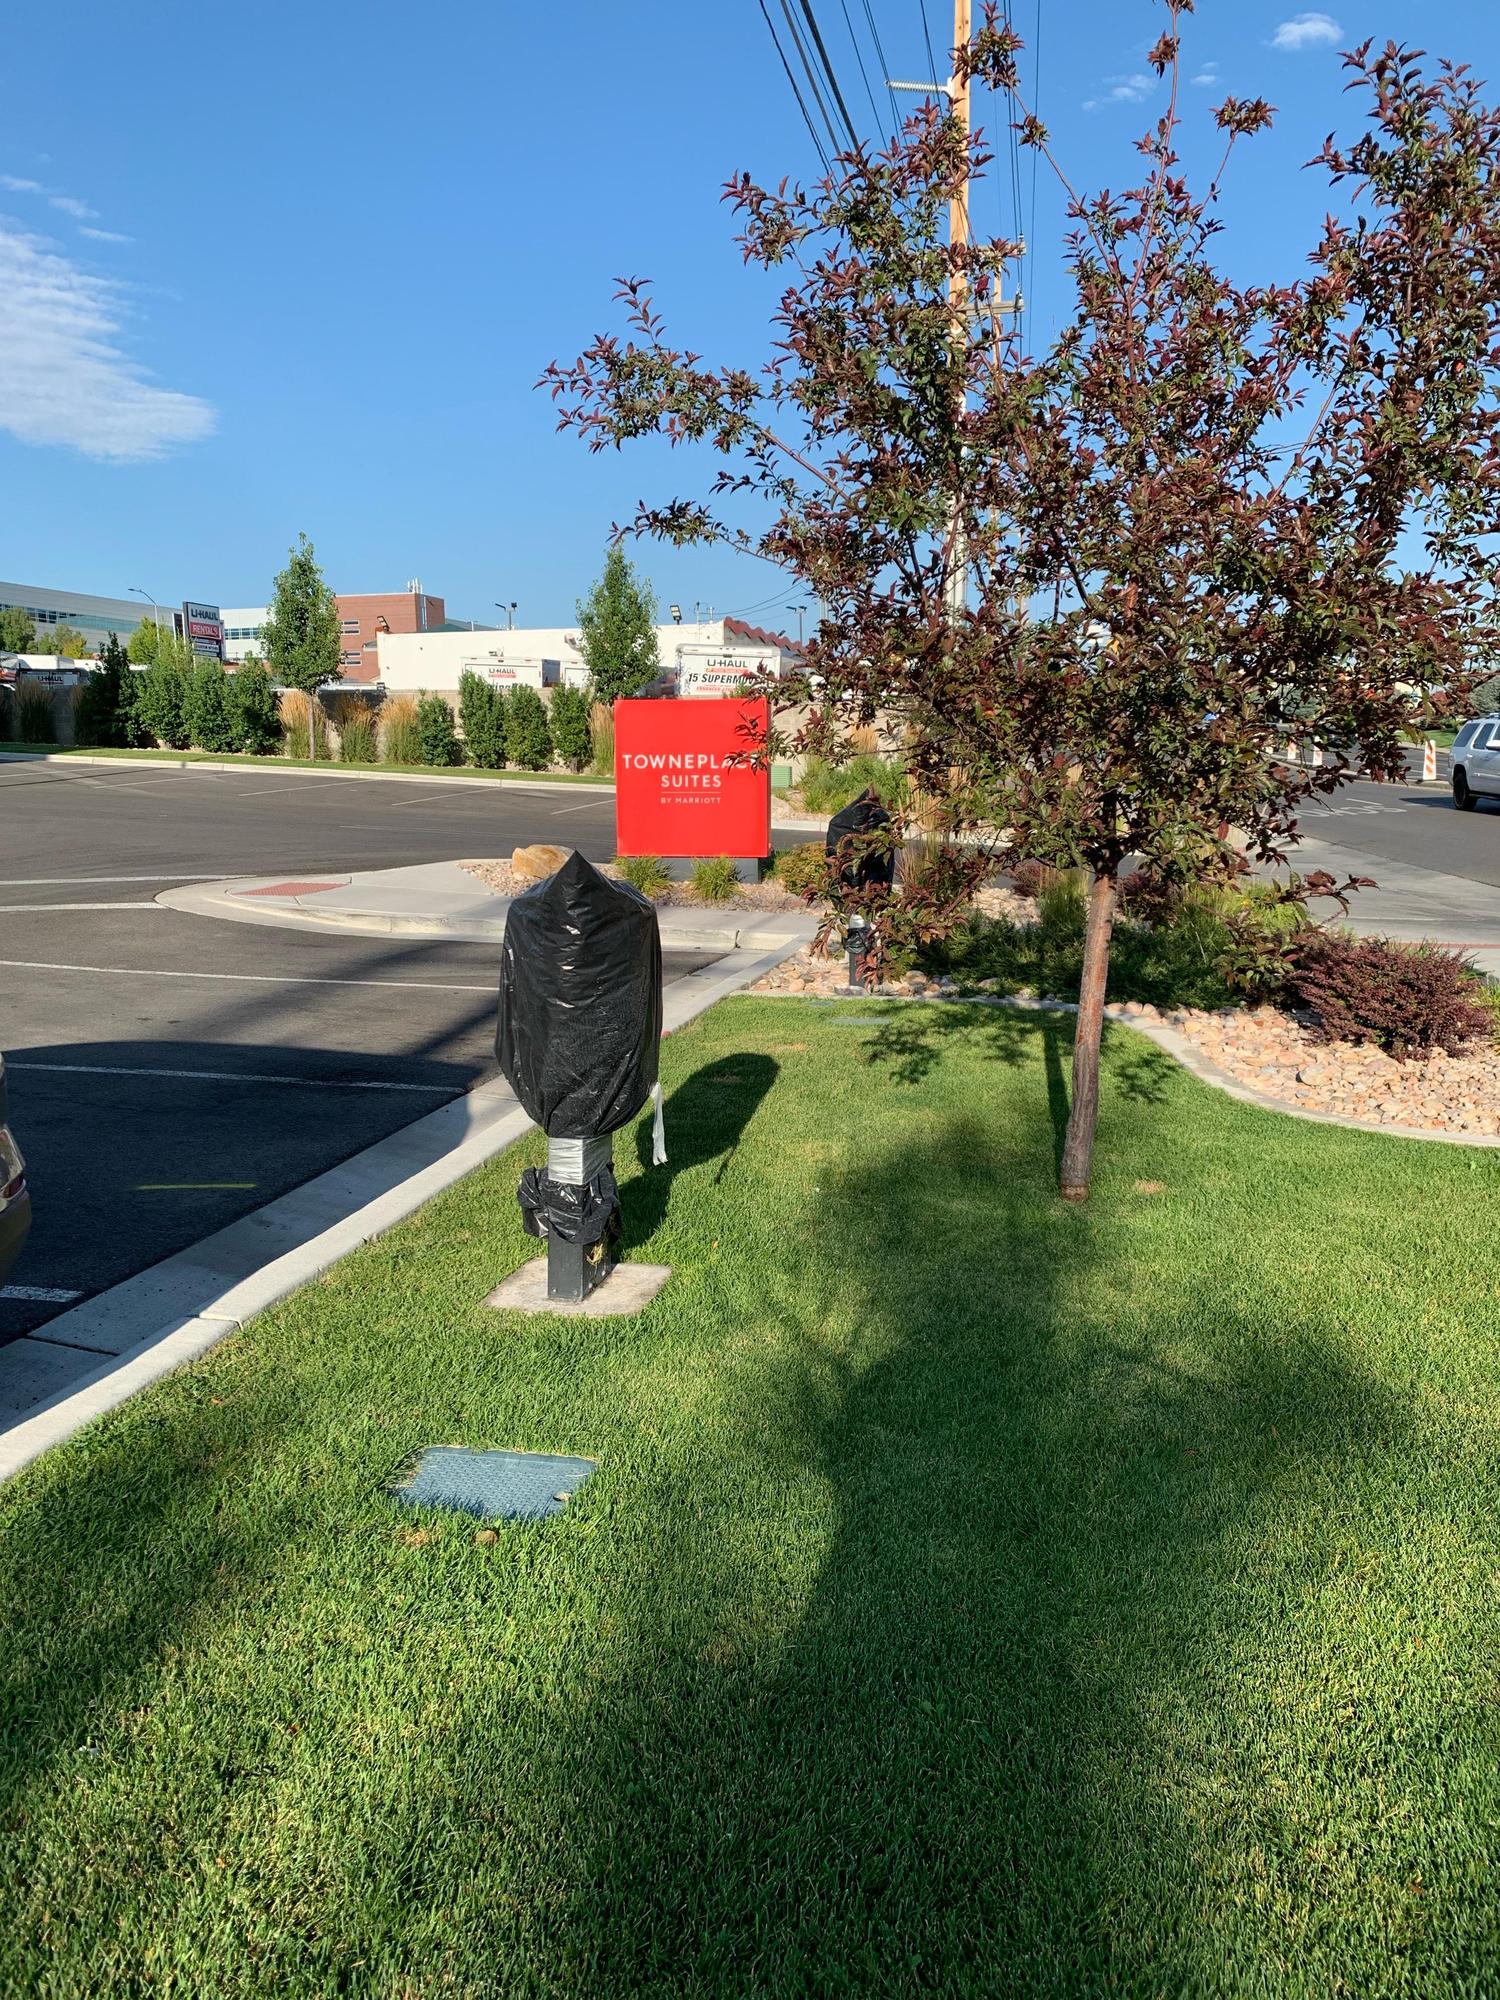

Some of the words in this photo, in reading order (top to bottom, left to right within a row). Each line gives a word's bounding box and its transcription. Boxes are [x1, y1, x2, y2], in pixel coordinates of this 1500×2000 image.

[191, 609, 218, 620] U-HAUL
[192, 624, 218, 636] RENTALS
[707, 658, 749, 668] U-HAUL
[622, 754, 757, 769] TOWNEPLAC
[661, 774, 722, 788] SUITES
[660, 796, 672, 805] BY
[675, 796, 722, 805] MARRIOTT
